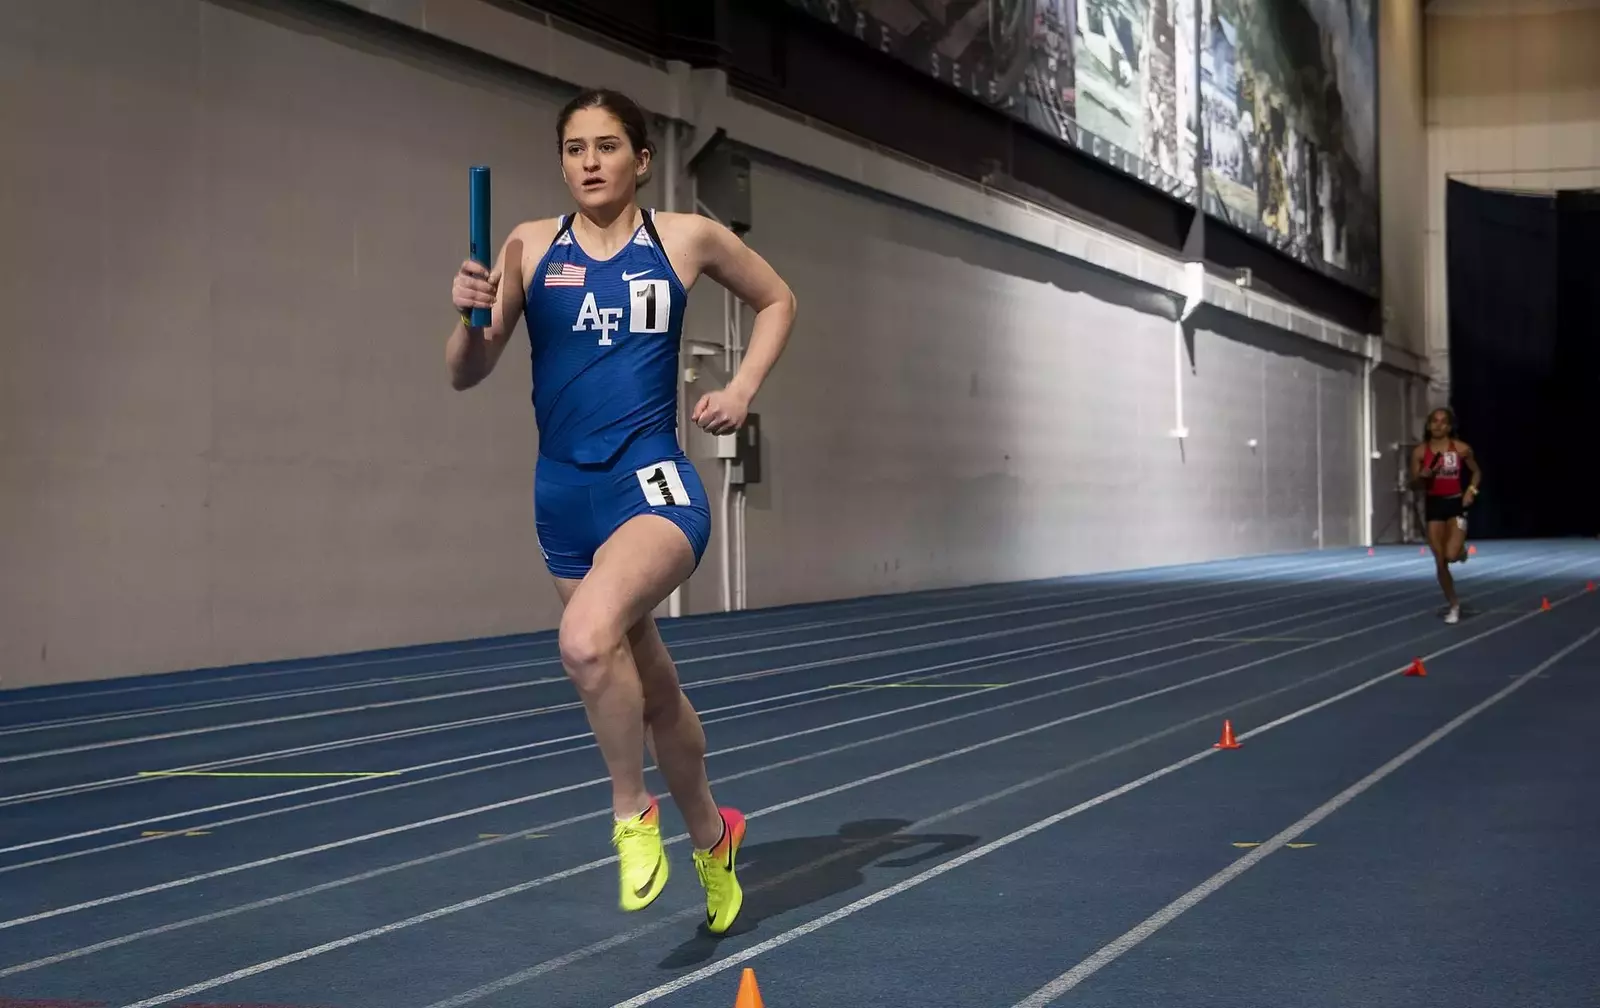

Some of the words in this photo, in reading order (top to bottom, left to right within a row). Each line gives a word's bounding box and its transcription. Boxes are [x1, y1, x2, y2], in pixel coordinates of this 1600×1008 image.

[572, 292, 623, 346] AF
[636, 283, 656, 330] 1
[646, 466, 676, 506] 1
